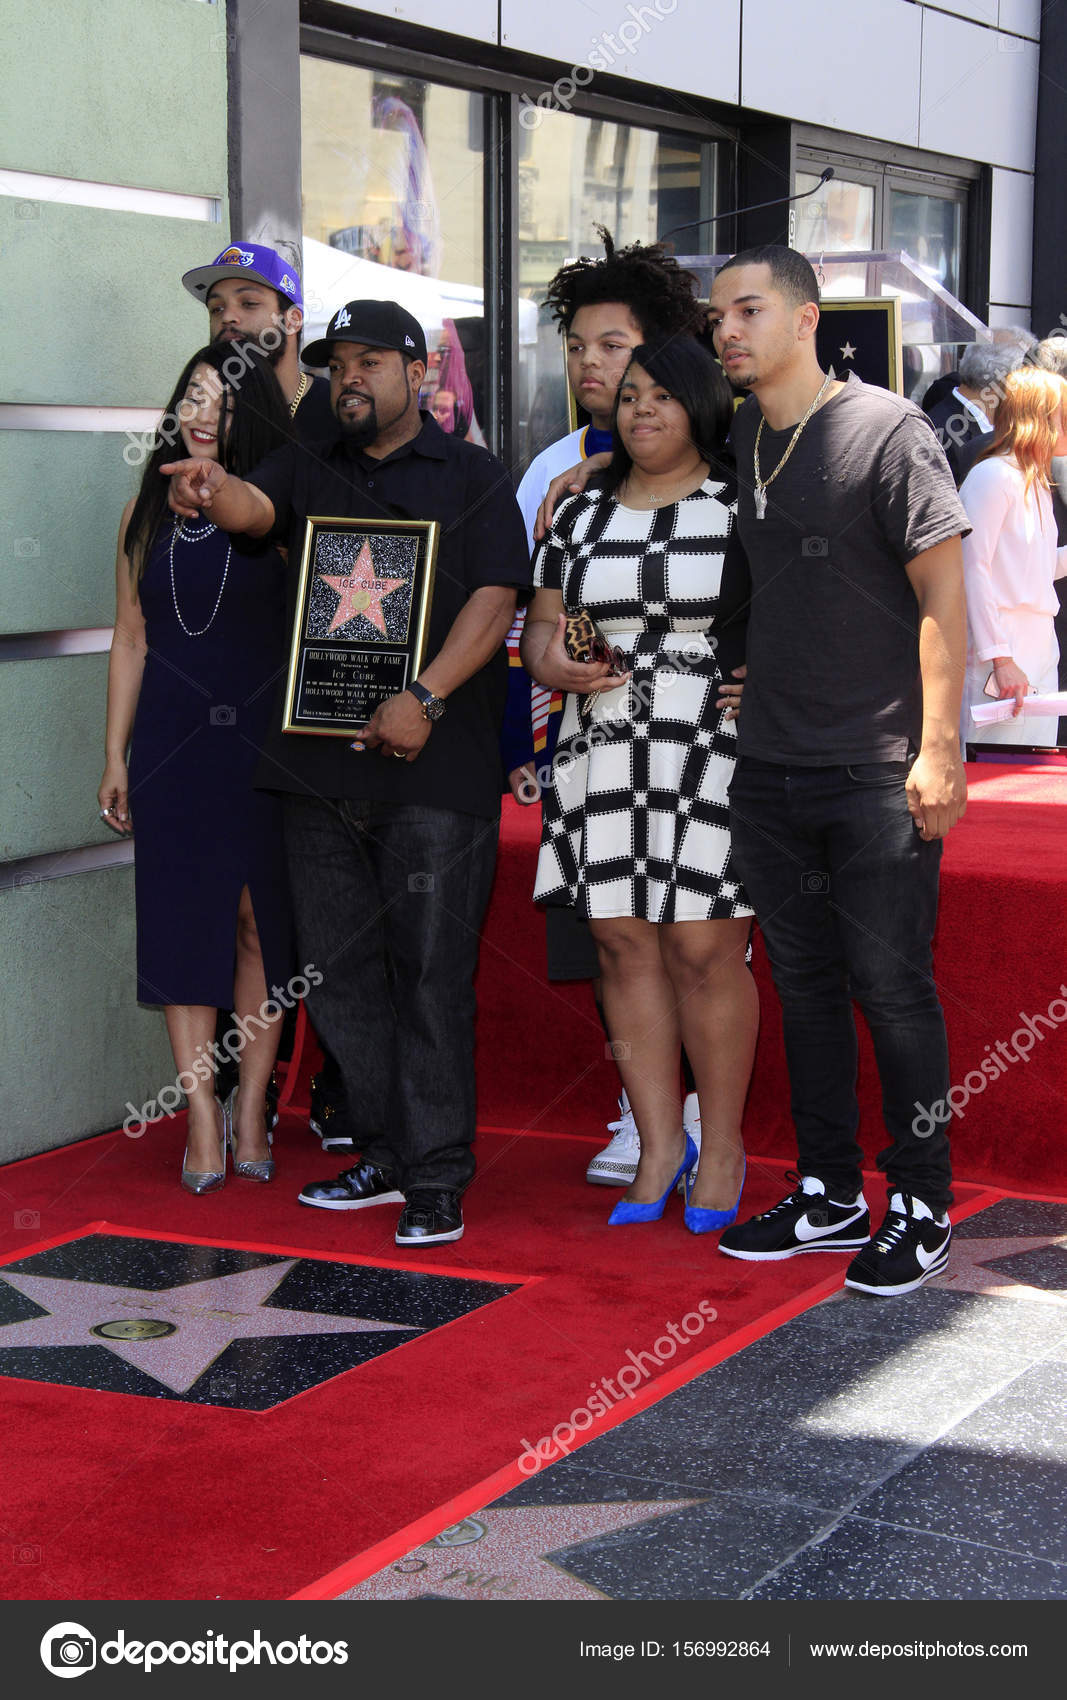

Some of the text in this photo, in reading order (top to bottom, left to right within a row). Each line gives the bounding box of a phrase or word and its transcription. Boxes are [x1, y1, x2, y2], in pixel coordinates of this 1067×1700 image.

[335, 306, 351, 330] LA
[339, 579, 388, 590] ICE CUBE
[309, 651, 402, 665] HOLLYWOOD WALK OF FAME
[306, 688, 344, 697] HOLLYWOOD
[347, 690, 365, 698] WALK
[369, 691, 377, 699] OF
